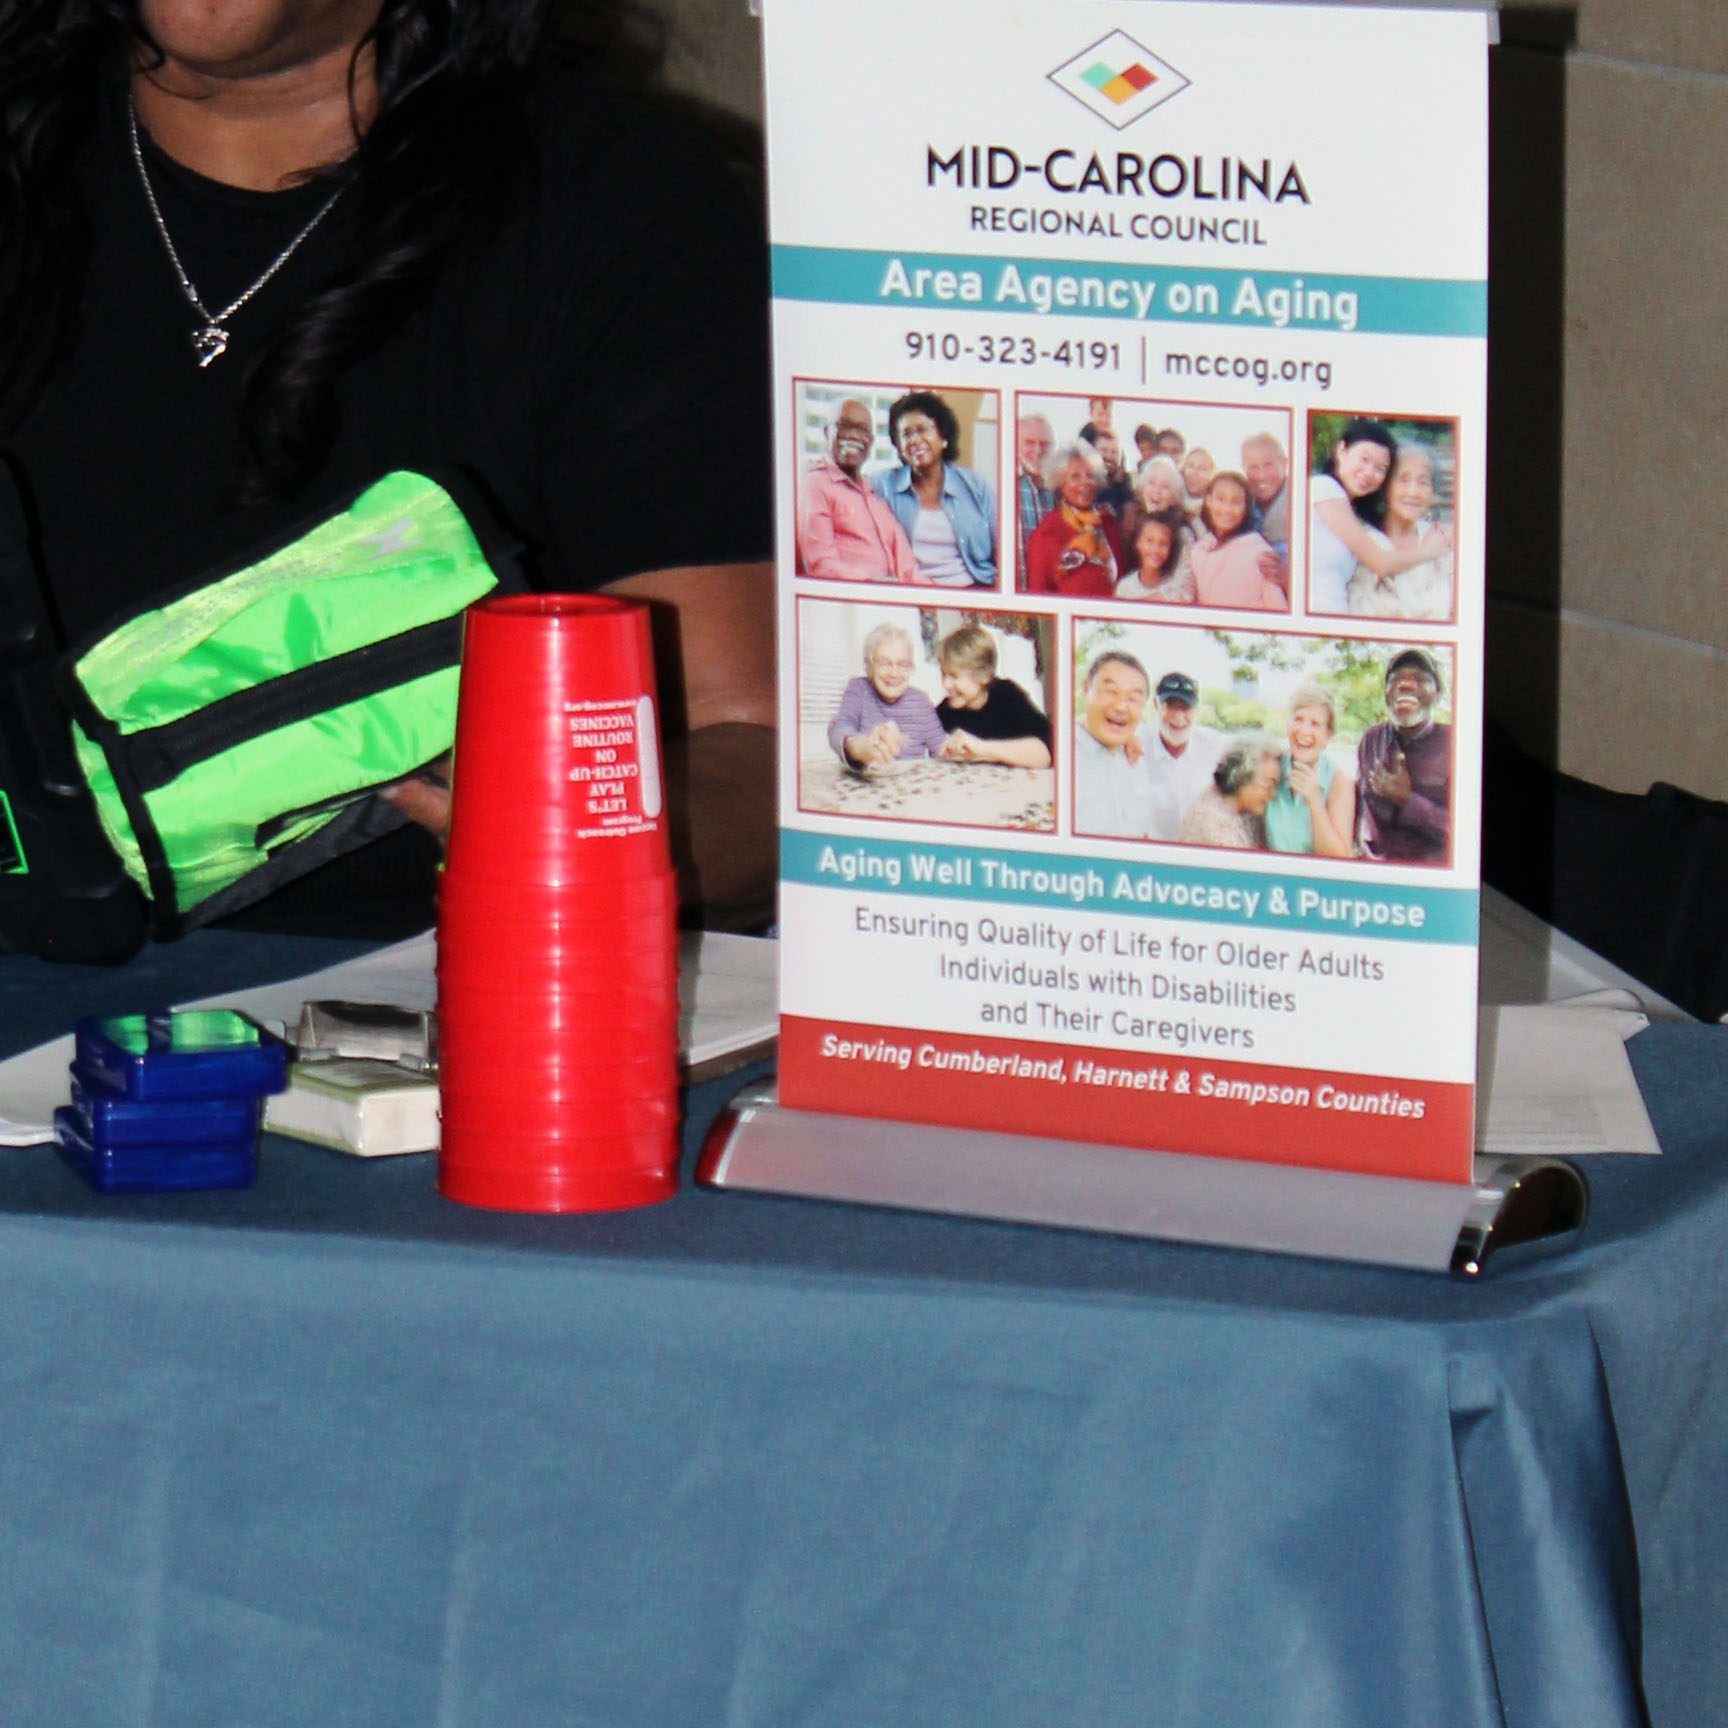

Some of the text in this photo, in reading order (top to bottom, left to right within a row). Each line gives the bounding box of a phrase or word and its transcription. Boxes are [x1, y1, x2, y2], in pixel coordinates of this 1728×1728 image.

[925, 143, 1311, 205] MID-CAROLINA
[971, 205, 1266, 246] REGIONAL COUNCIL
[881, 258, 1360, 332] Area Agency on Aging
[905, 332, 1333, 389] 910-323-4191 mccog.org
[570, 714, 635, 731] VACCINES
[573, 731, 633, 748] ROUTINE
[570, 763, 639, 781] CATCH-UP
[596, 749, 617, 763] ON
[588, 798, 627, 814] LET'S
[590, 781, 625, 797] PLAY
[819, 846, 1427, 932] Aging Well Through Advocacy & Purpose
[855, 907, 1385, 982] Ensuring Quality of Life for Older Adults
[940, 955, 1297, 1013] Individuals with Disabilities
[980, 999, 1256, 1050] and Their Caregivers
[821, 1033, 1427, 1120] Serving Cumberland, Harnett & Sampson Counties
